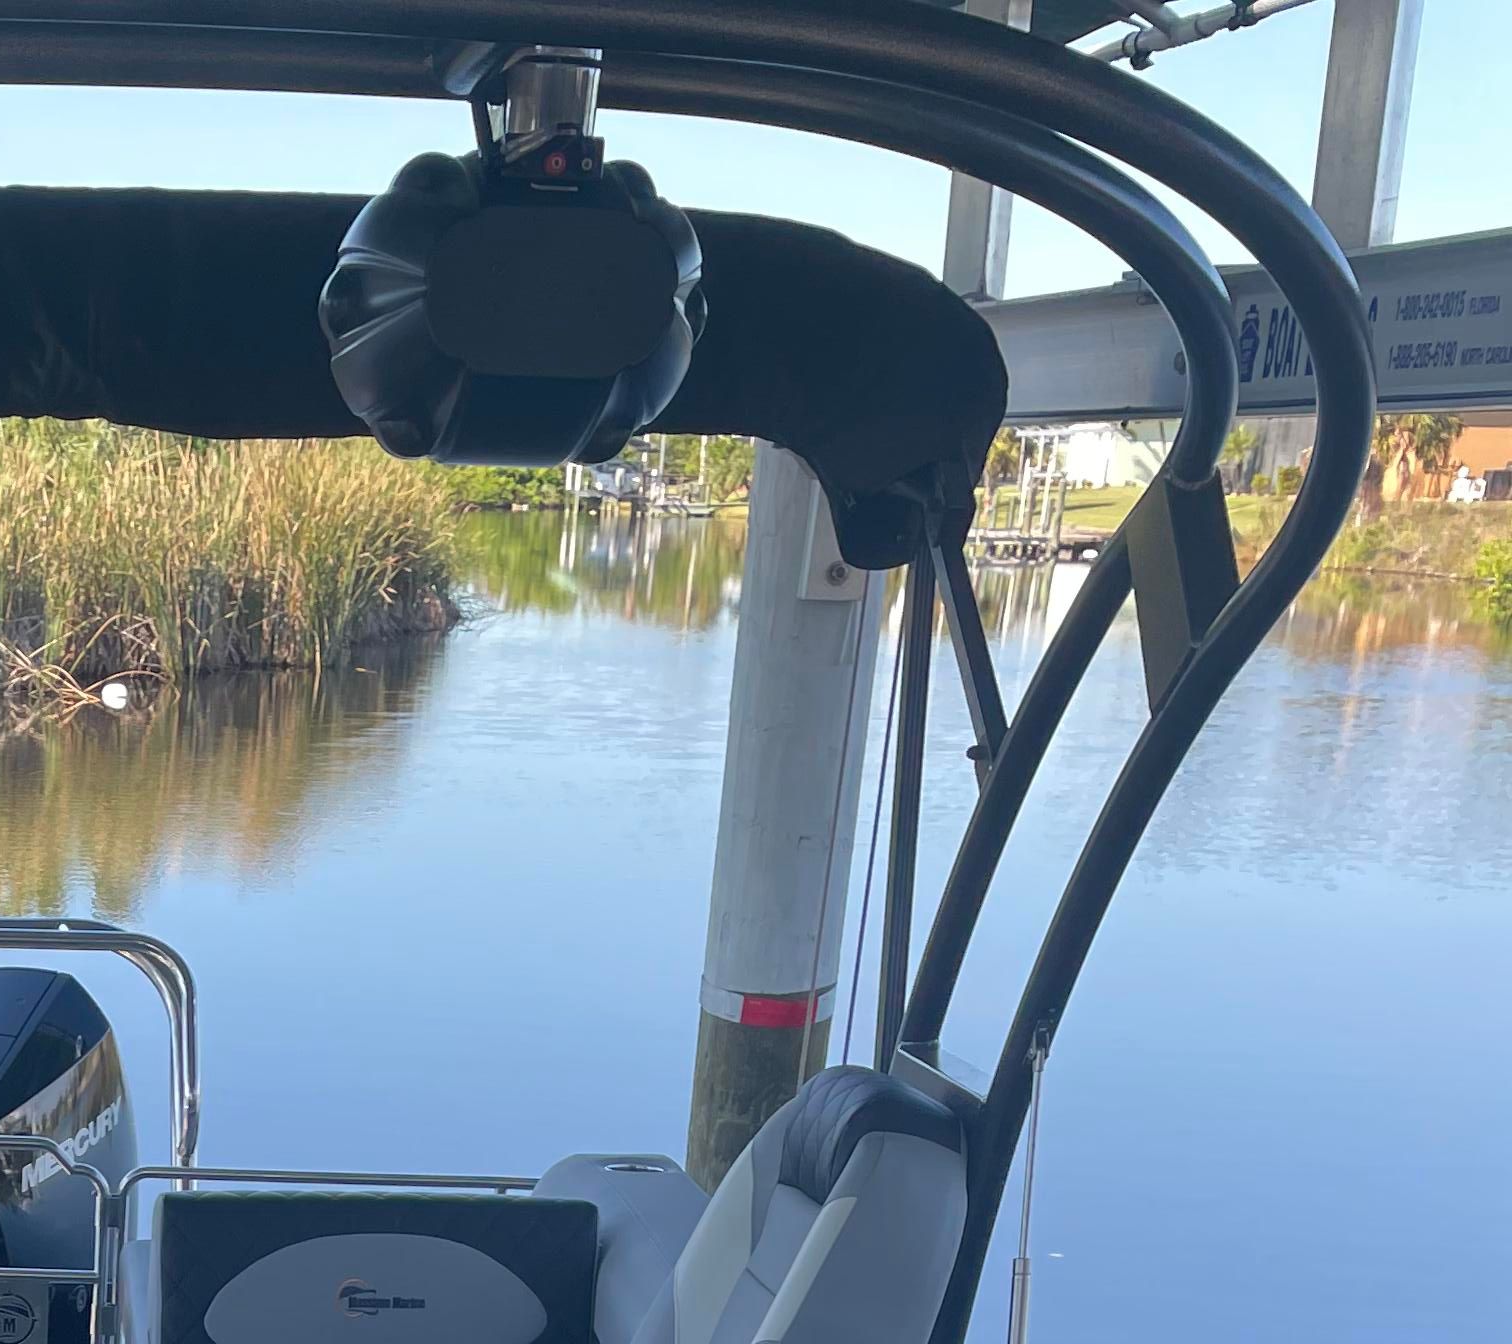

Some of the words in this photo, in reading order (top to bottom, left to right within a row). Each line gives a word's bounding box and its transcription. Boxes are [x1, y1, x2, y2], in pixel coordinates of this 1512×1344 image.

[21, 1095, 122, 1193] MERCURY
[348, 1296, 391, 1308] Massimo
[392, 1296, 426, 1309] Marine
